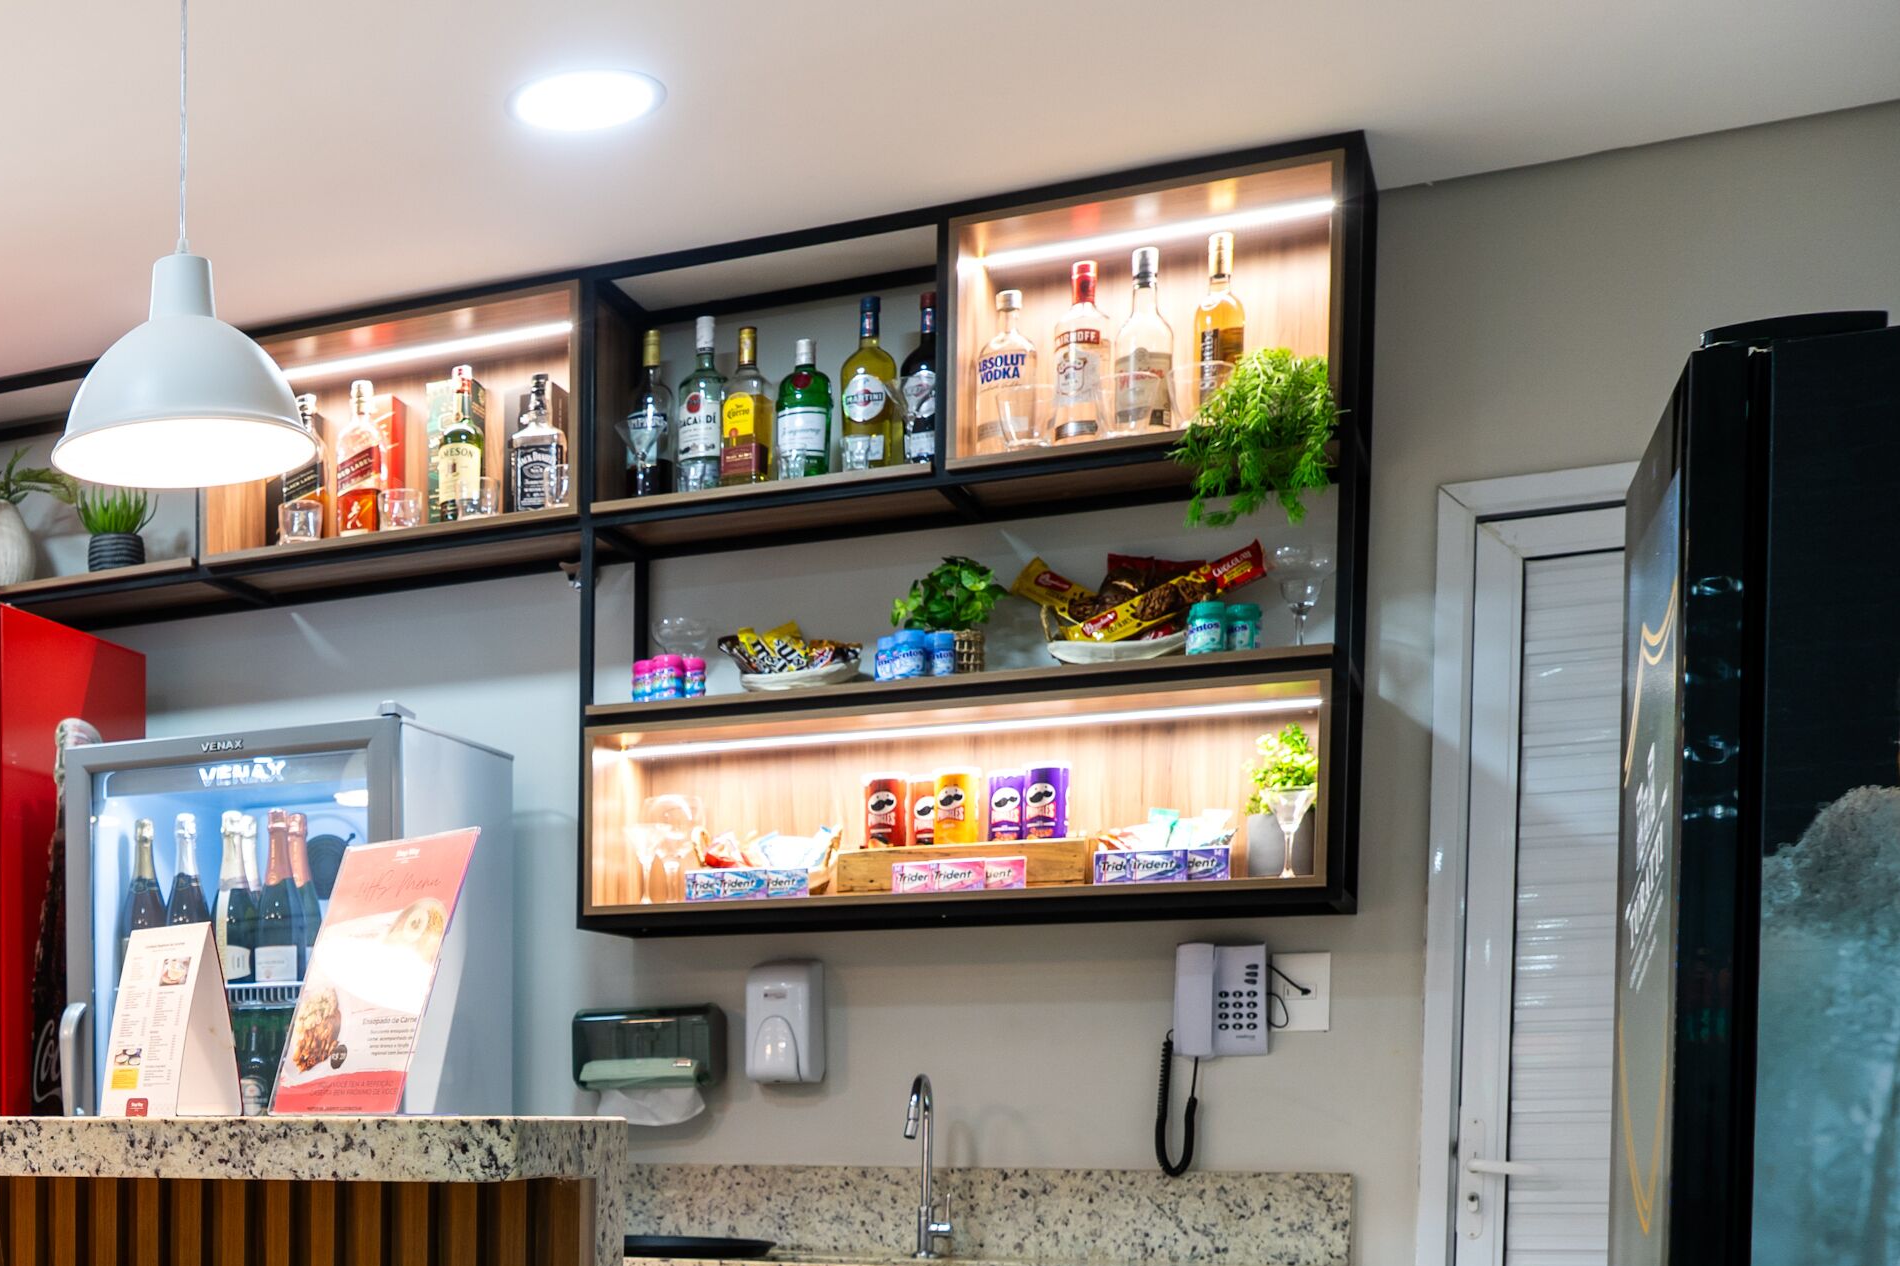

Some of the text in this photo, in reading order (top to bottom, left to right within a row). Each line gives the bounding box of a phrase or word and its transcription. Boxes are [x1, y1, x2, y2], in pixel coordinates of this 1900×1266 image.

[979, 353, 1027, 373] ABSOLUT
[980, 366, 1021, 385] VODKA
[1187, 622, 1221, 635] entos
[201, 740, 244, 753] VENAX
[1132, 859, 1176, 871] Trident
[1188, 857, 1217, 868] dent
[934, 870, 973, 880] Trident
[720, 878, 755, 888] Trident
